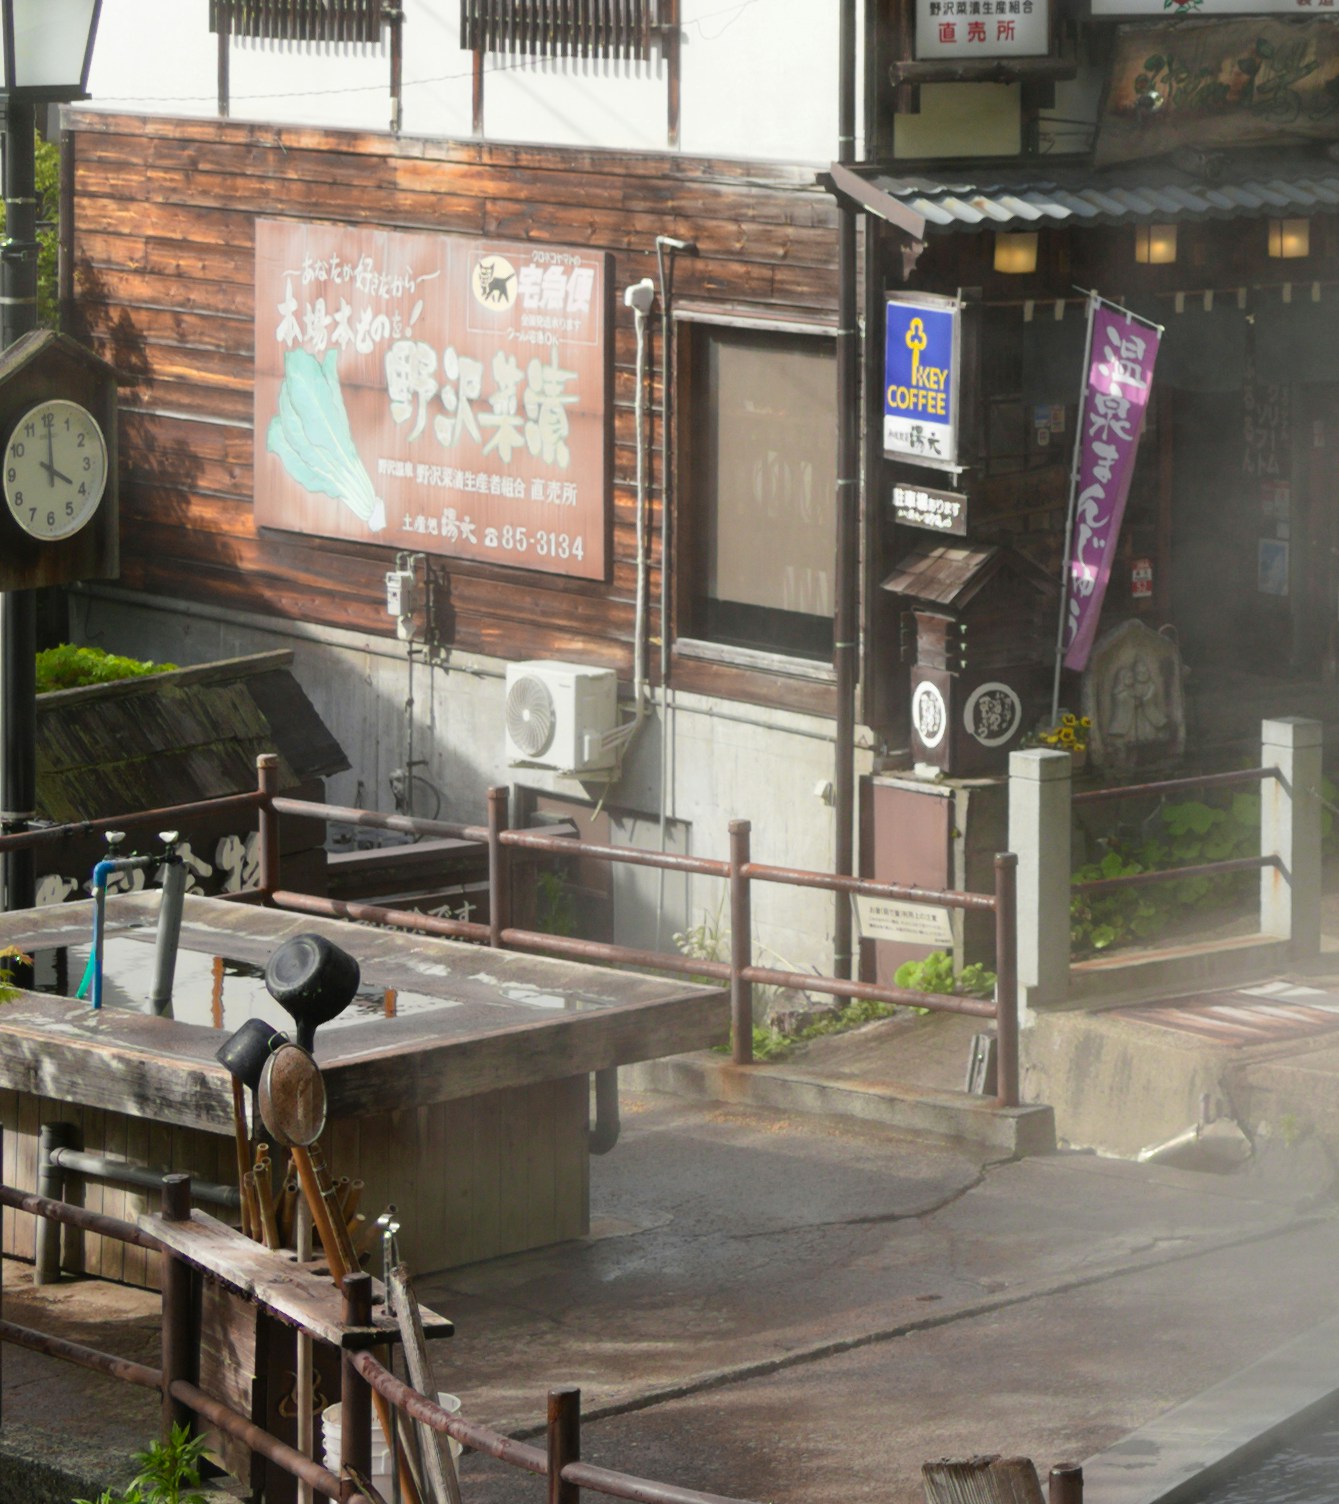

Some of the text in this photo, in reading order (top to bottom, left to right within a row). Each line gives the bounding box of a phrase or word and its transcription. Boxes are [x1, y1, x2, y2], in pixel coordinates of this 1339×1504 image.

[929, 0, 1035, 17] 野沢菜漬生産組合
[937, 20, 1017, 44] 直売所
[518, 263, 595, 313] 宅急便
[917, 365, 948, 391] KEY
[384, 339, 581, 469] 野沢菜漬
[887, 384, 946, 416] COFFEE
[41, 413, 55, 428] 12
[64, 418, 71, 432] 1
[24, 423, 35, 438] 11
[77, 433, 85, 448] 2
[10, 442, 25, 458] 10
[83, 457, 91, 472] 3
[7, 468, 16, 483] 9
[77, 482, 86, 497] 4
[530, 478, 578, 507] 直売所
[14, 491, 23, 507] 8
[29, 507, 37, 522] 7
[65, 502, 74, 517] 5
[47, 511, 55, 526] 6
[502, 525, 584, 561] 85-3134
